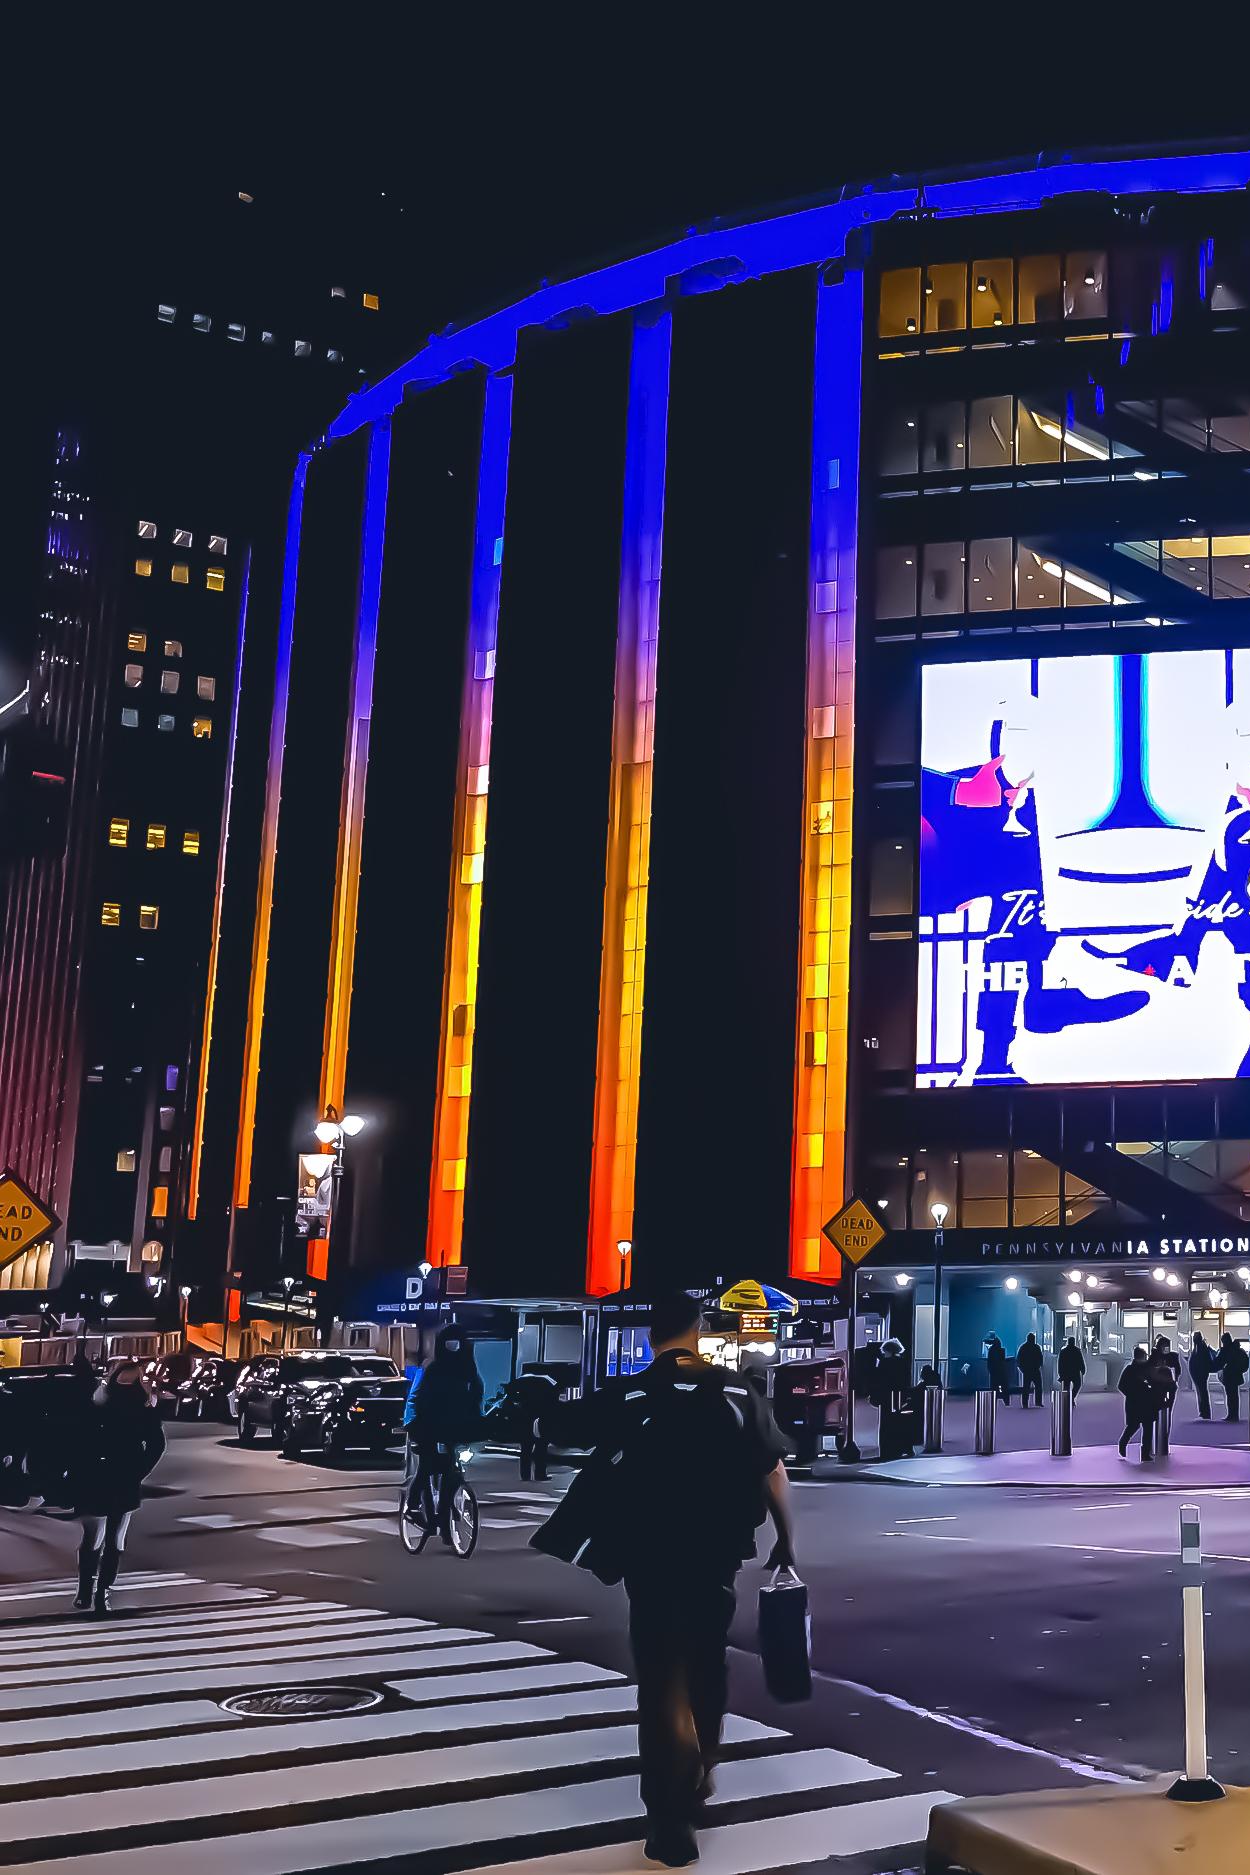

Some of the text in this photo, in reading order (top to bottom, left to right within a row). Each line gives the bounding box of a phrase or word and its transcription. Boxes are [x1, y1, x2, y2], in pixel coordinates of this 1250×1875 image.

[841, 1217, 874, 1230] DEAD
[0, 1226, 23, 1242] ND
[844, 1234, 868, 1247] END
[1159, 1237, 1250, 1255] STATION
[405, 1277, 423, 1299] D
